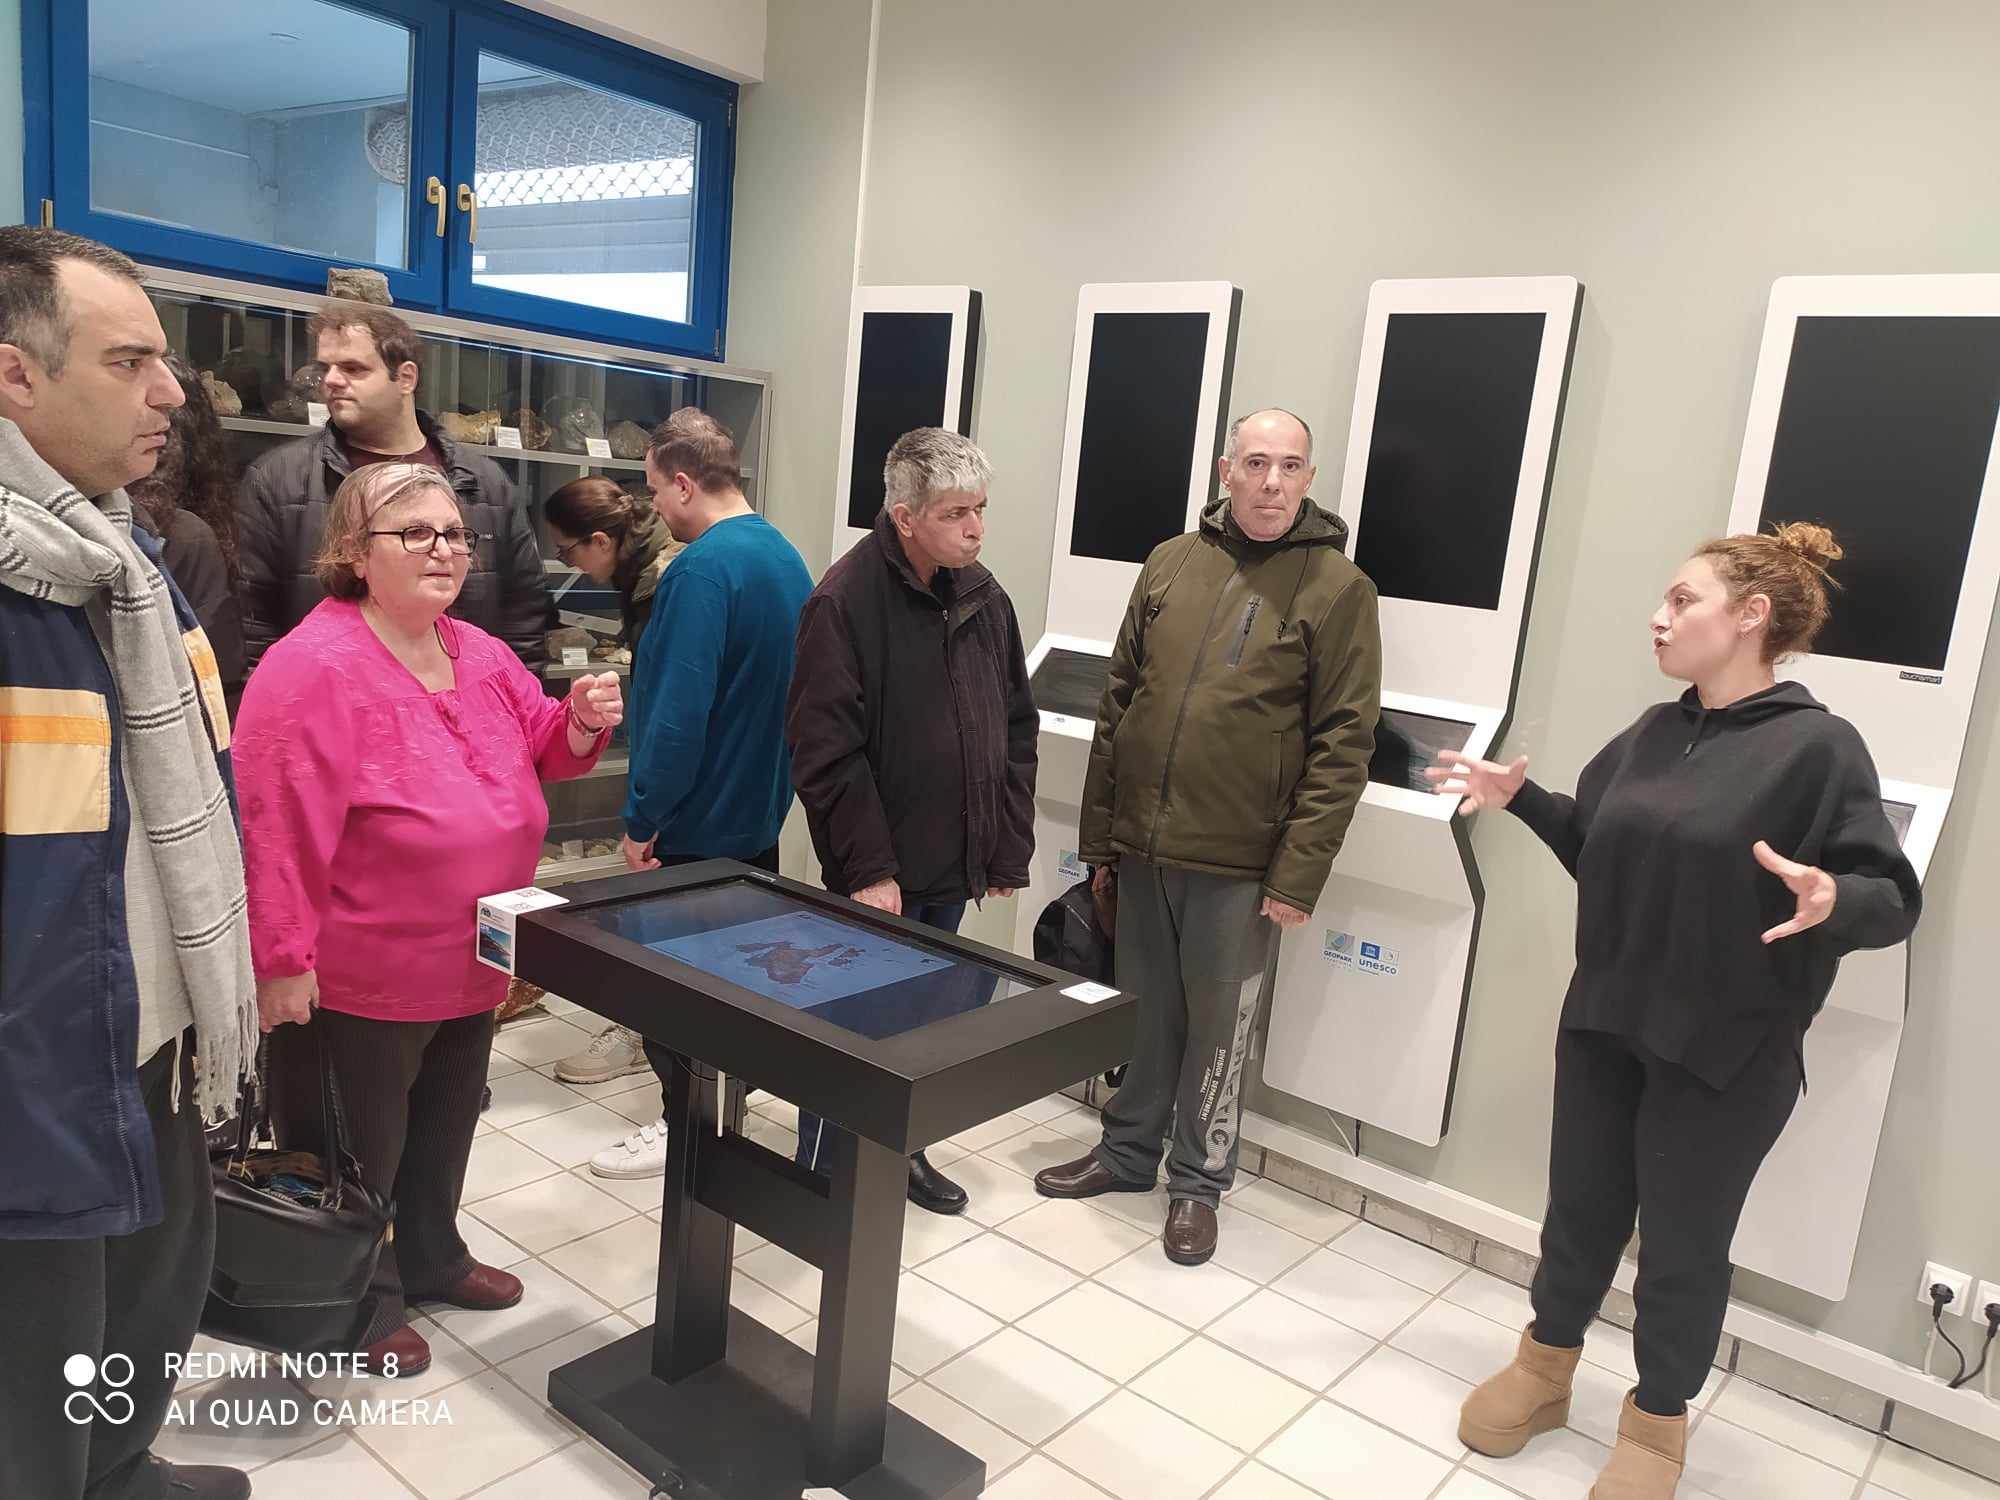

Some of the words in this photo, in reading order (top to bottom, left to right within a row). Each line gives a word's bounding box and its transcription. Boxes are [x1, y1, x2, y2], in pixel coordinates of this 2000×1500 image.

[1323, 950, 1353, 963] GEOPARK
[1359, 958, 1397, 975] unesco
[1215, 1049, 1227, 1078] DIVISION
[1200, 1080, 1219, 1121] DEPARTMENT
